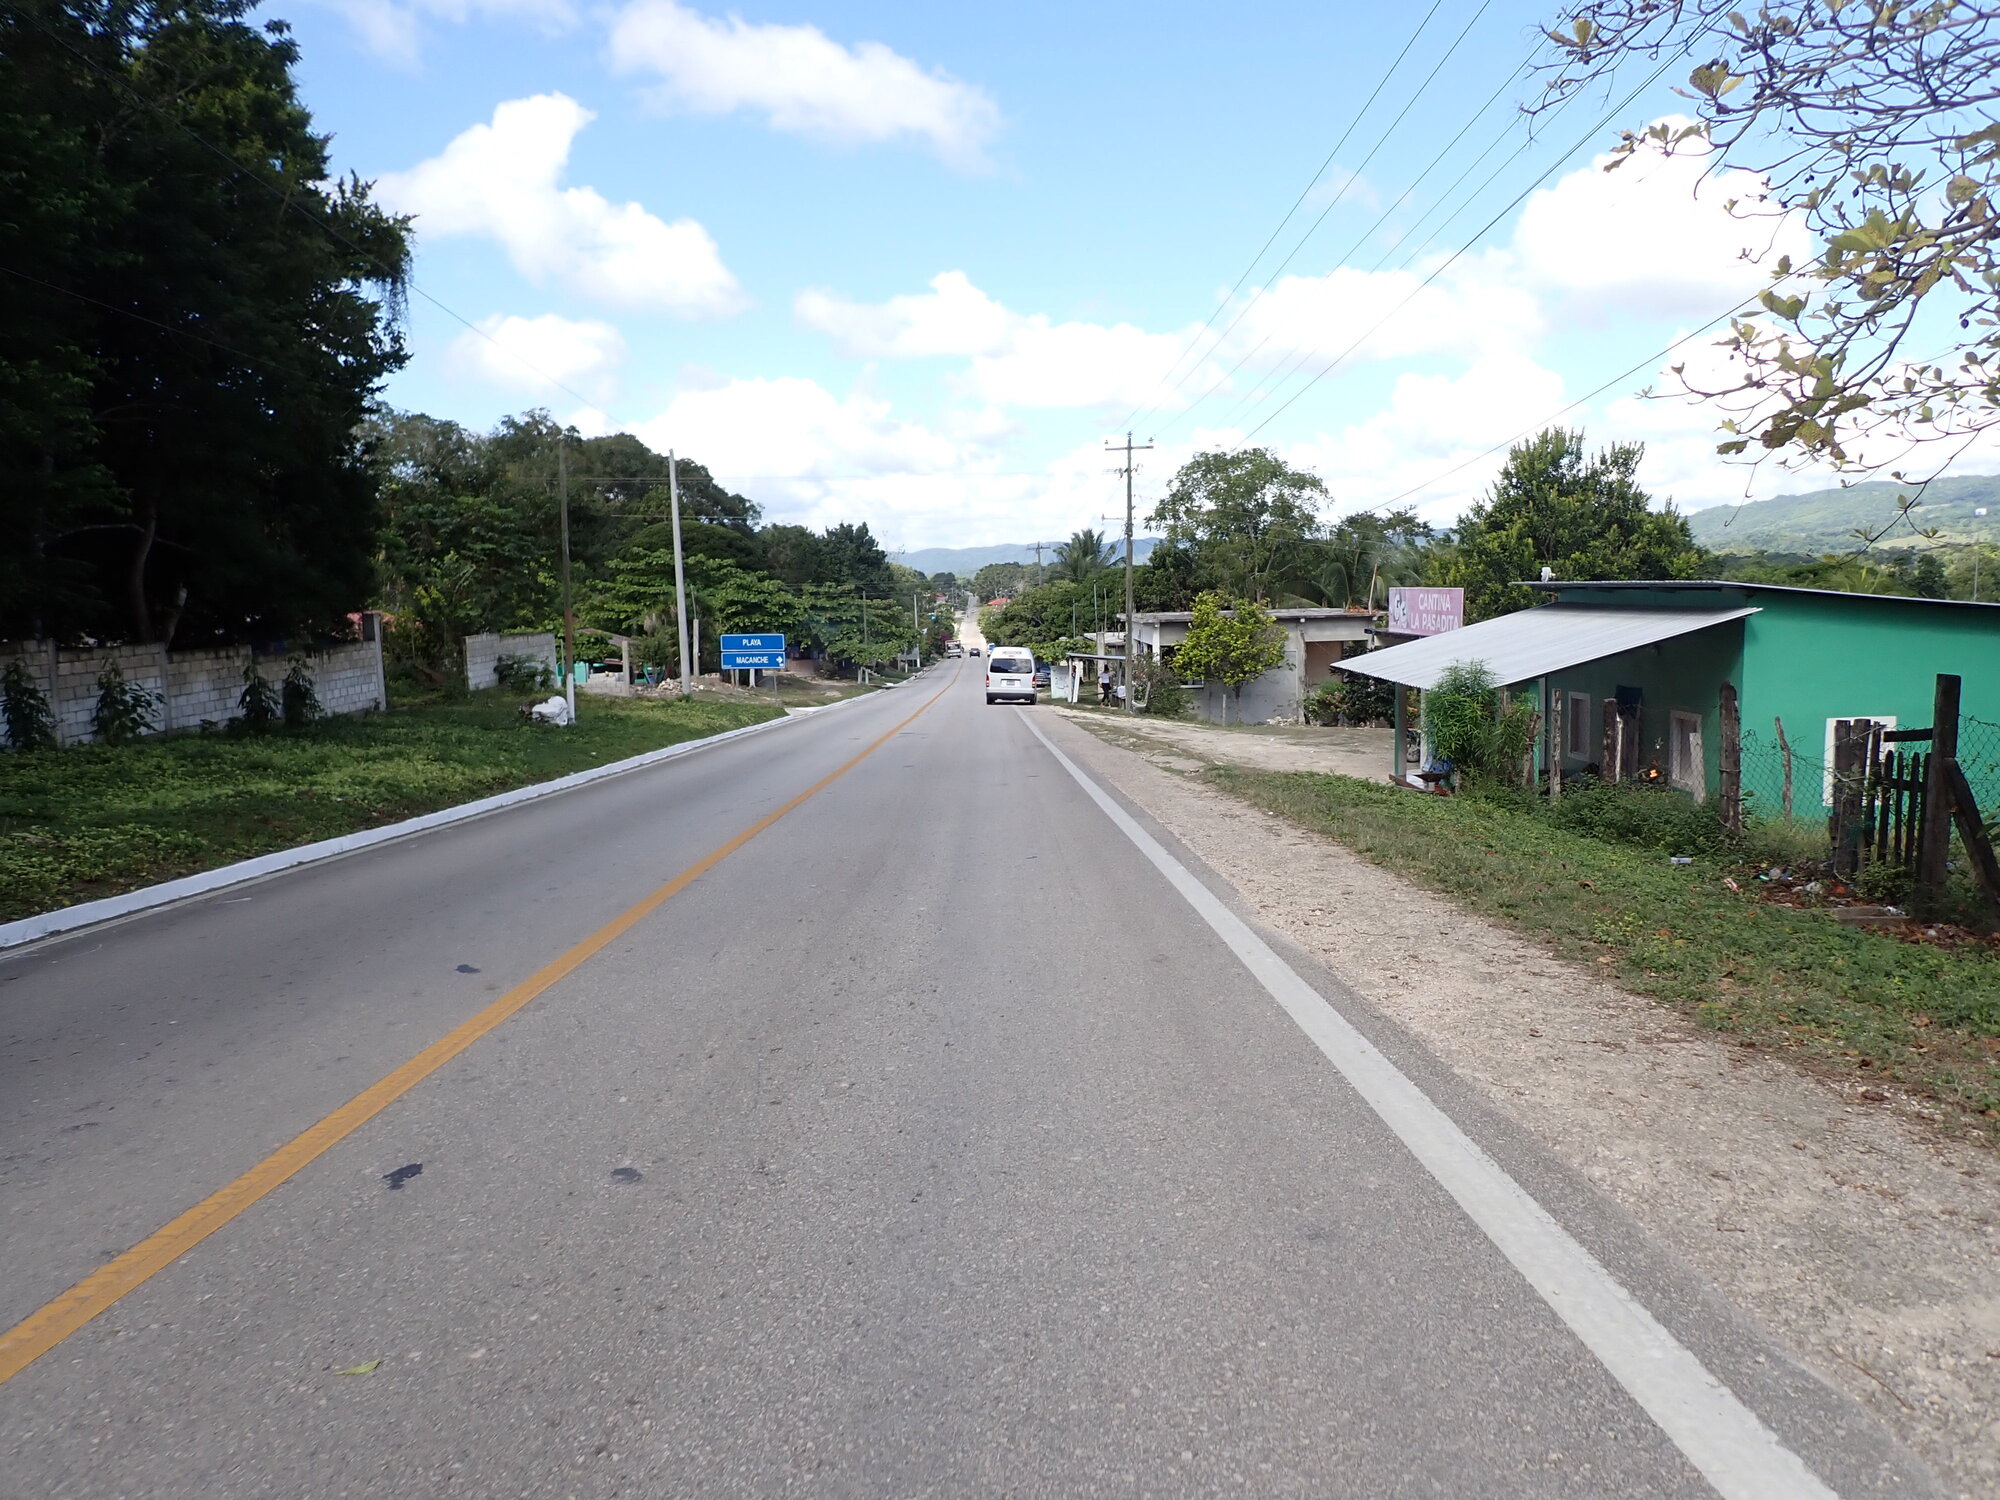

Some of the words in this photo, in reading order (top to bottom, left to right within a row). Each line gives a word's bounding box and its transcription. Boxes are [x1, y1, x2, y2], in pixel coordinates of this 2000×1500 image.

[1418, 593, 1451, 611] CANTINA
[1410, 613, 1420, 629] LA
[1422, 613, 1459, 632] PASADITA
[742, 638, 762, 646] PLAYA
[736, 656, 769, 664] MACANCHE
